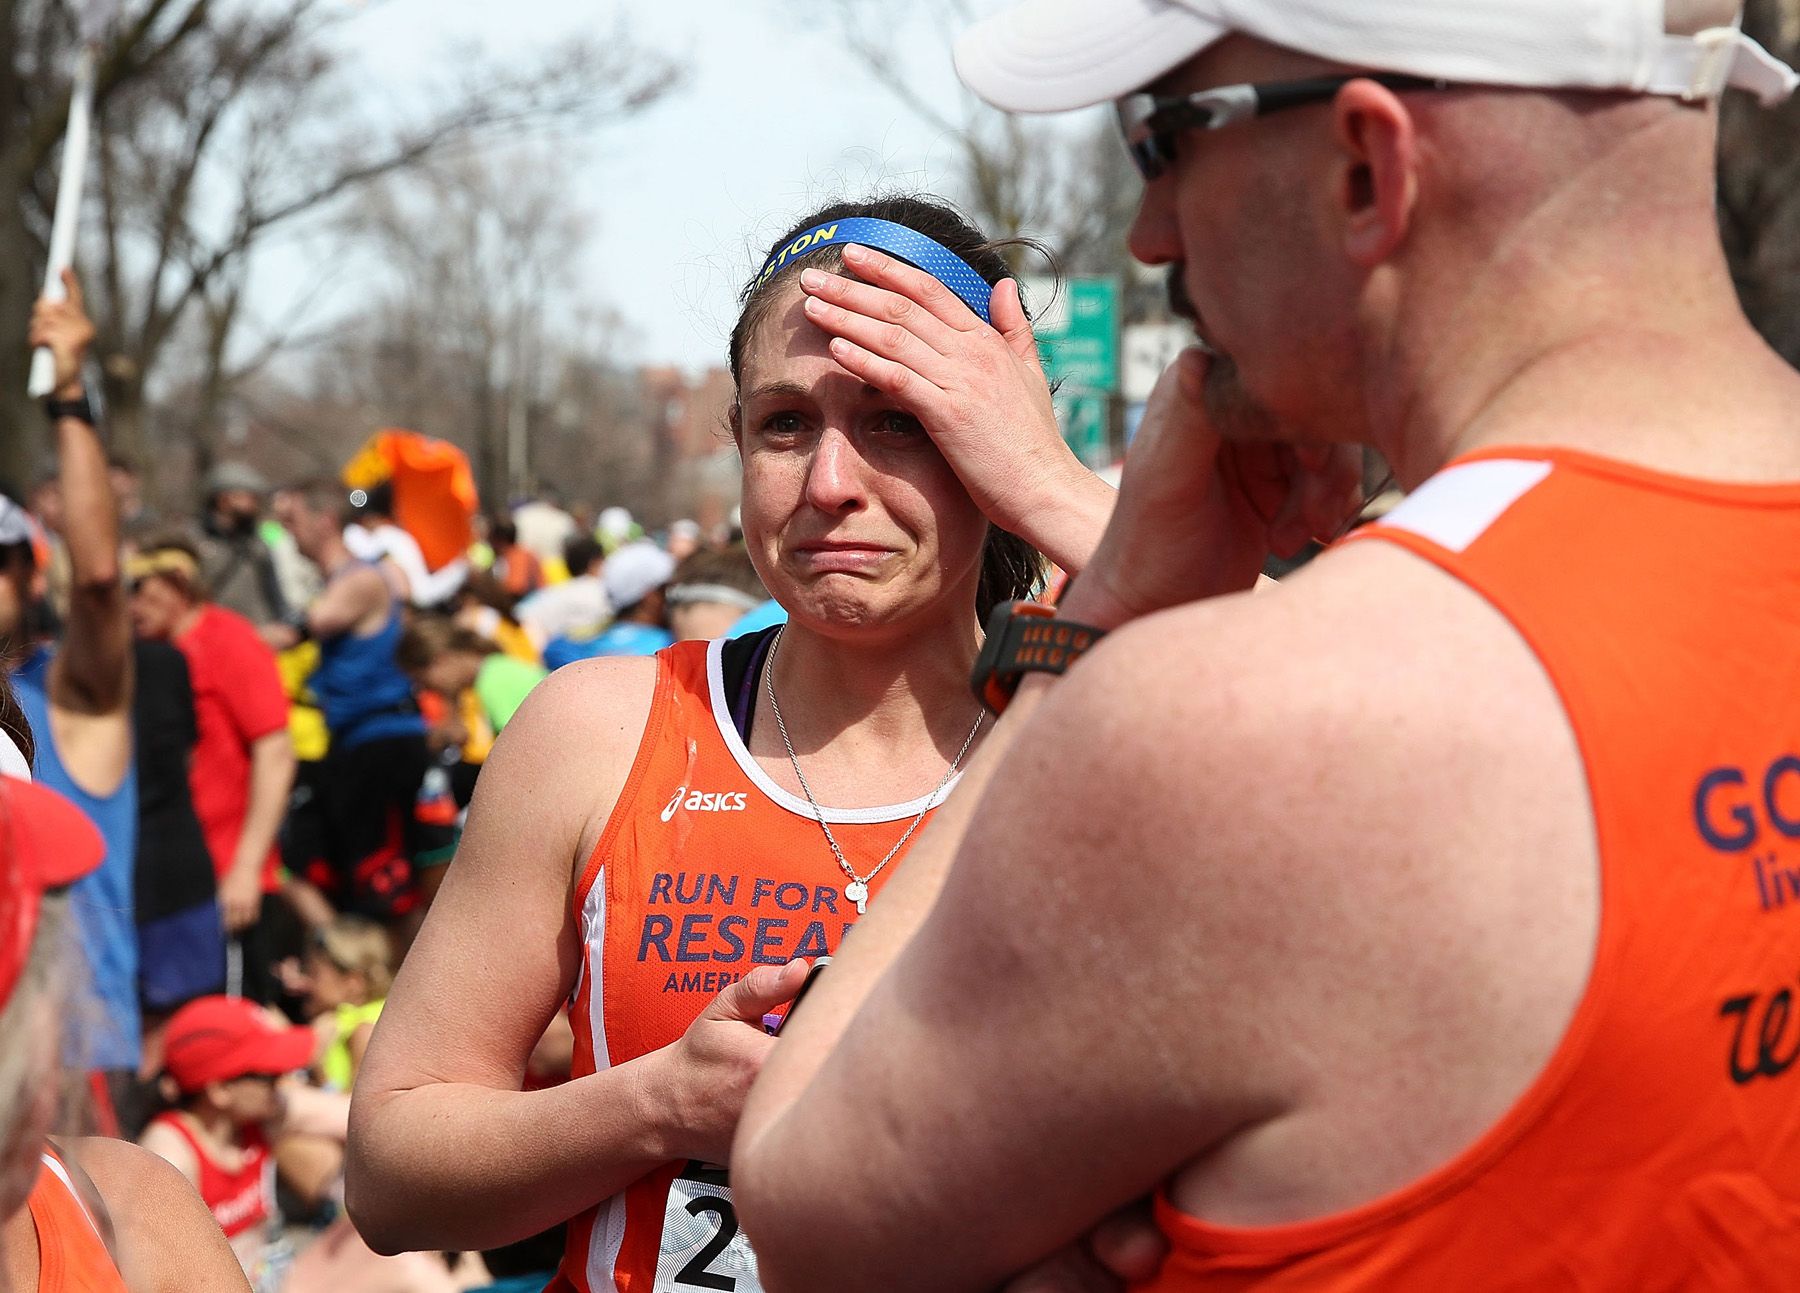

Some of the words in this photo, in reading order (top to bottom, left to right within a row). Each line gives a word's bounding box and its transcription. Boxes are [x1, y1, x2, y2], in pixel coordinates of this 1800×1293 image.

[755, 224, 839, 291] STON
[684, 791, 748, 812] asics
[648, 872, 739, 906] RUN
[751, 878, 839, 915] FOR
[674, 1195, 740, 1293] 2
